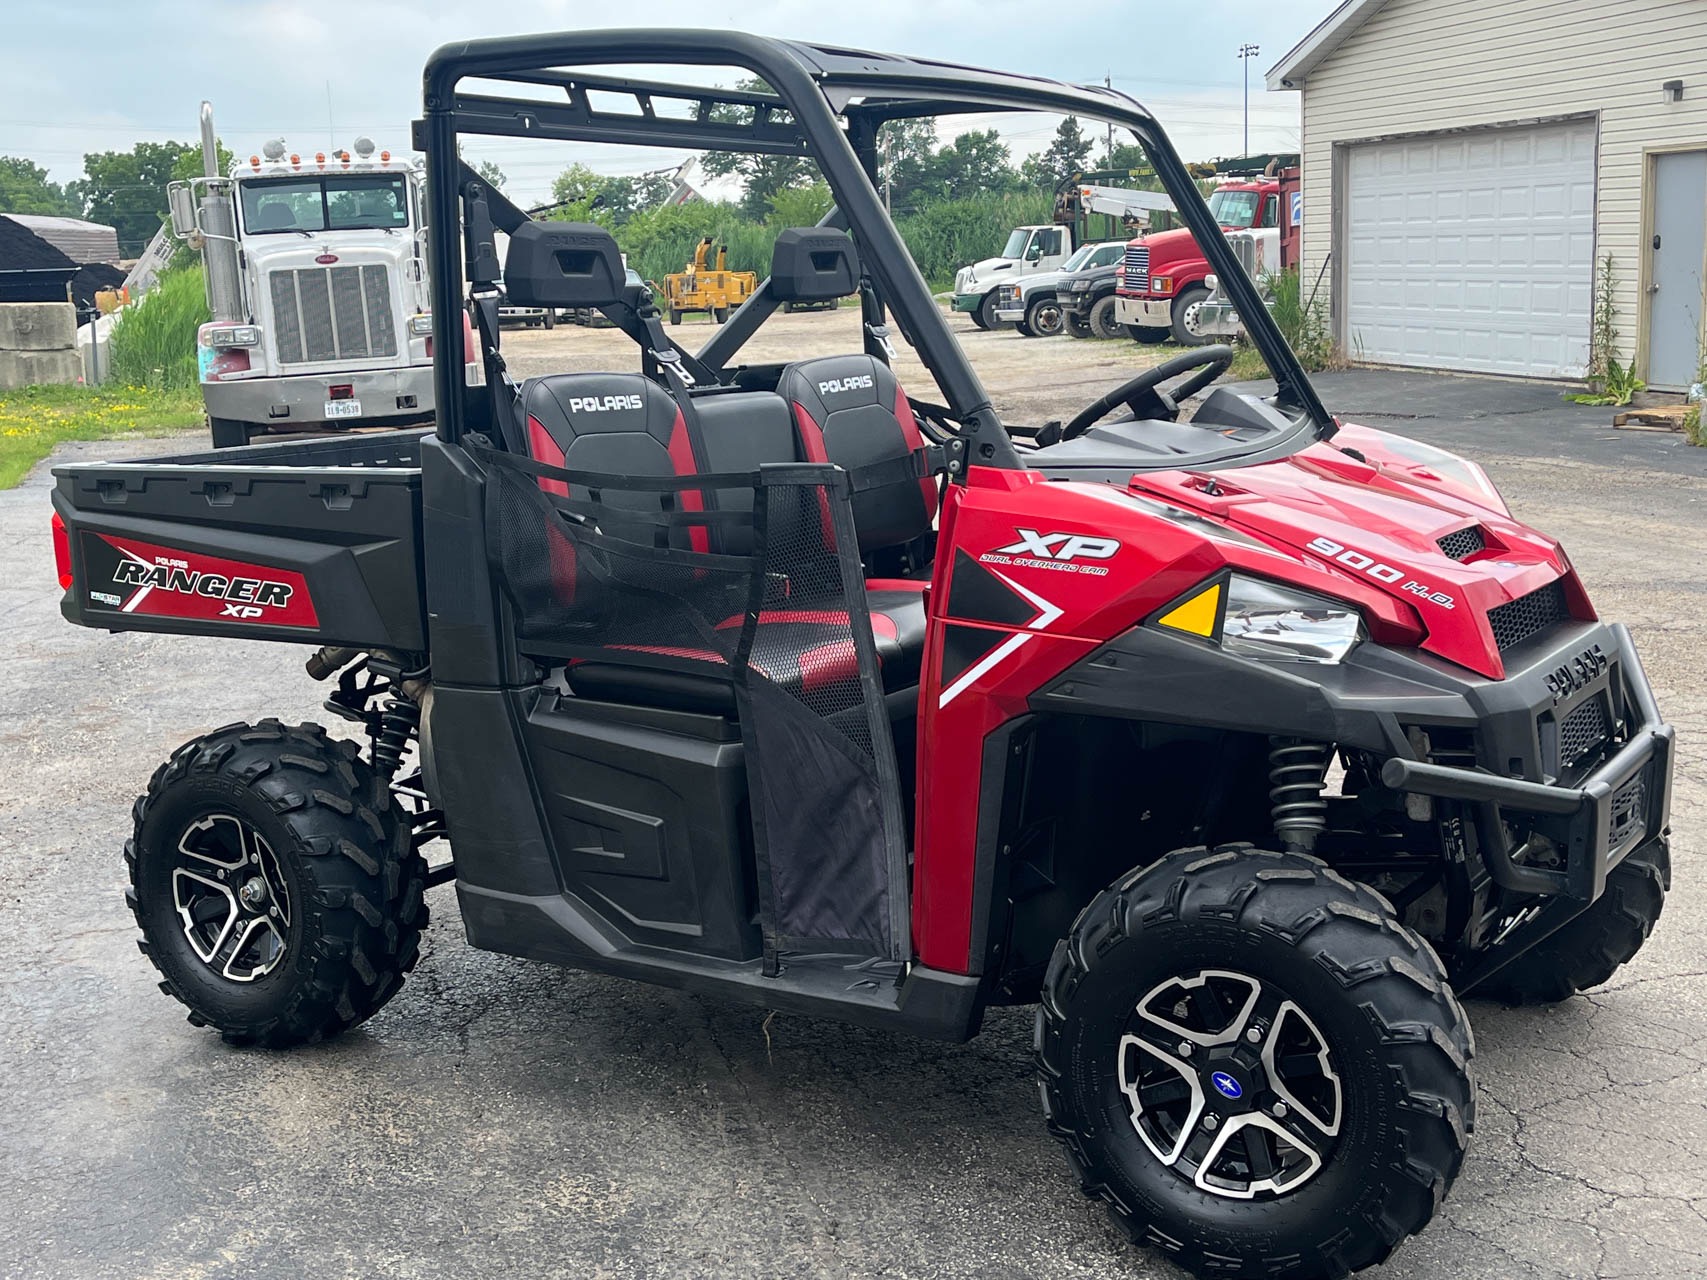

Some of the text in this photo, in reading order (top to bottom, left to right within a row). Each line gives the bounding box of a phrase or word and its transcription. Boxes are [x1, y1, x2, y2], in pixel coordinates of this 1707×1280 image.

[1126, 267, 1148, 275] MACK
[819, 375, 873, 395] POLARIS
[569, 394, 643, 413] POLARIS
[993, 528, 1121, 560] XP
[155, 556, 189, 569] POLARIS
[979, 553, 1109, 576] DUAL OVERHEAD CAM
[1306, 537, 1405, 583] 900
[113, 559, 294, 608] RANGER
[219, 603, 263, 618] XP
[1542, 644, 1607, 707] POLARIS
